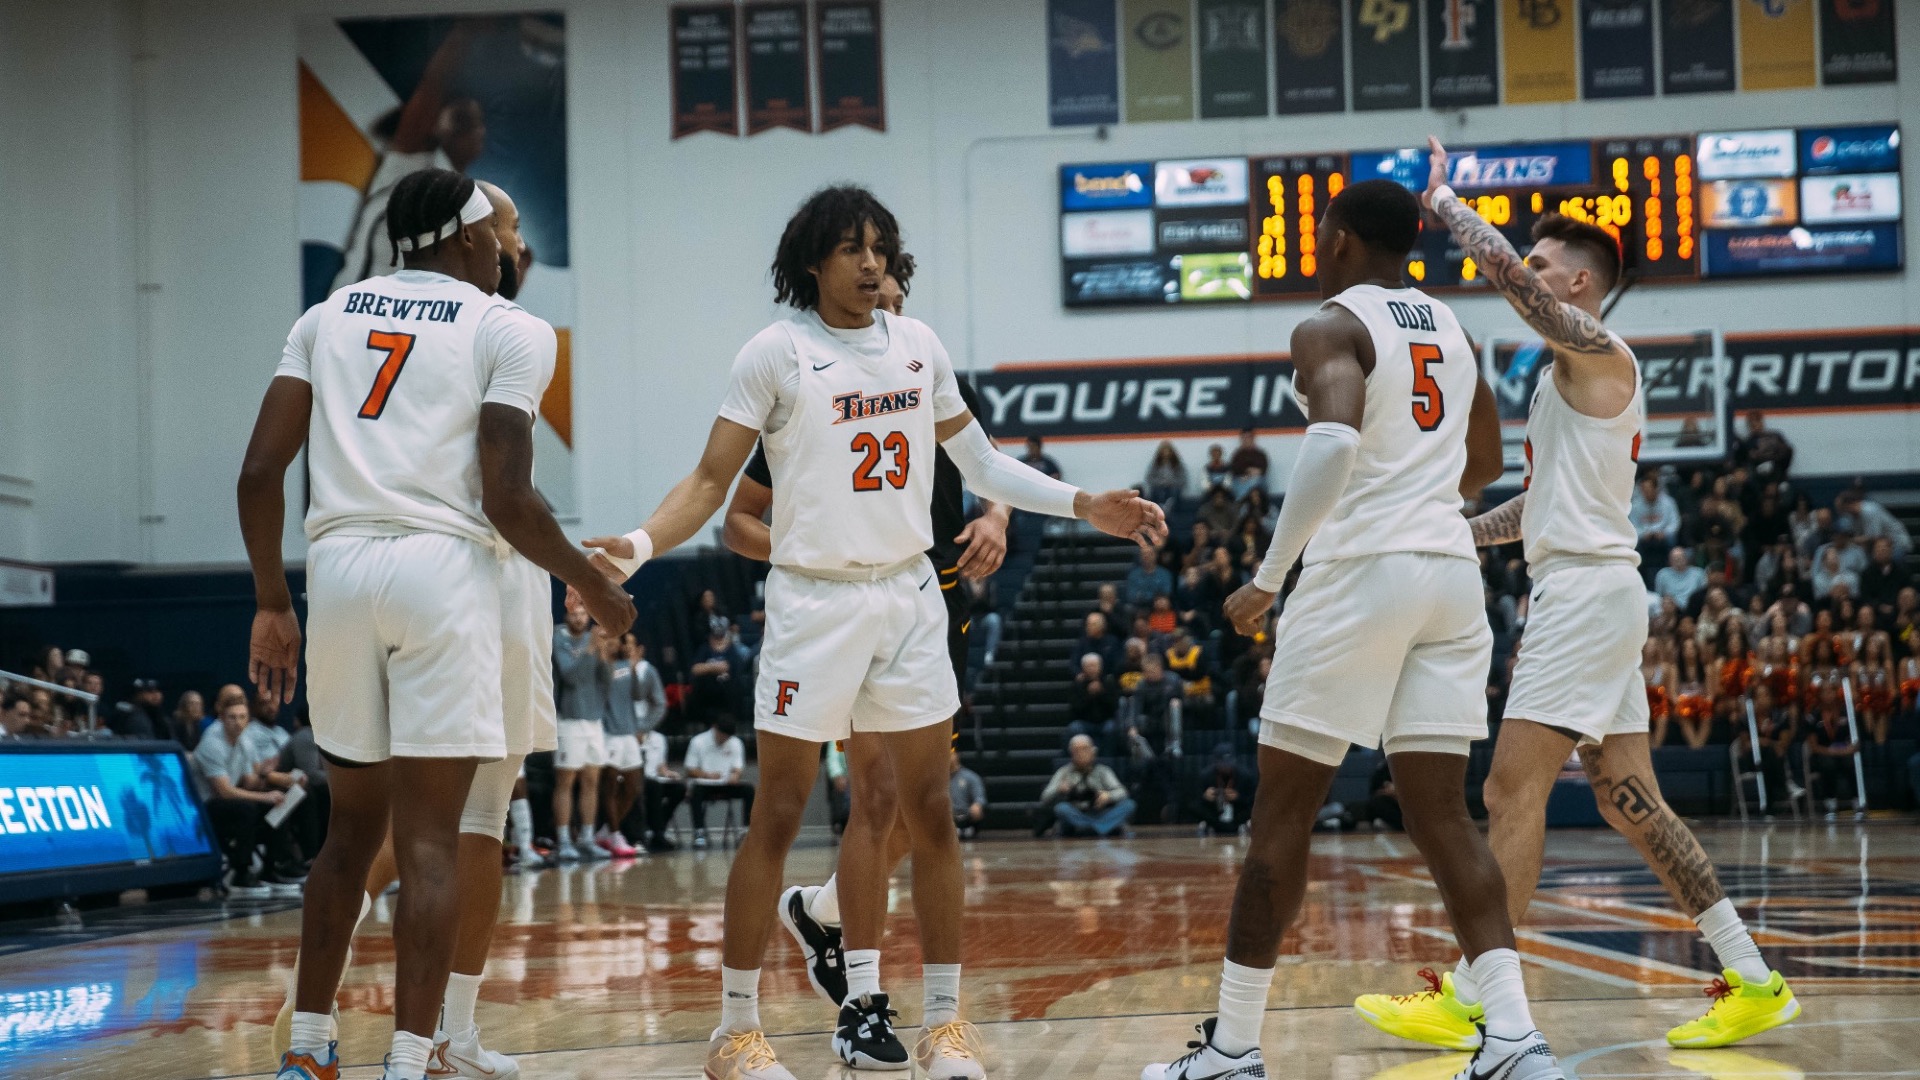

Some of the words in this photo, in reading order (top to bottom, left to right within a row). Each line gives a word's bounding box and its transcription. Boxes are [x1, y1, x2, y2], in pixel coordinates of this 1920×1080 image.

[343, 292, 463, 323] BREWTON
[1386, 301, 1437, 332] ODAY
[357, 329, 416, 420] 7
[1408, 342, 1445, 432] 5
[981, 375, 1231, 426] YOU'RE
[850, 431, 910, 492] 23
[772, 679, 800, 717] F
[0, 784, 112, 835] ERTON
